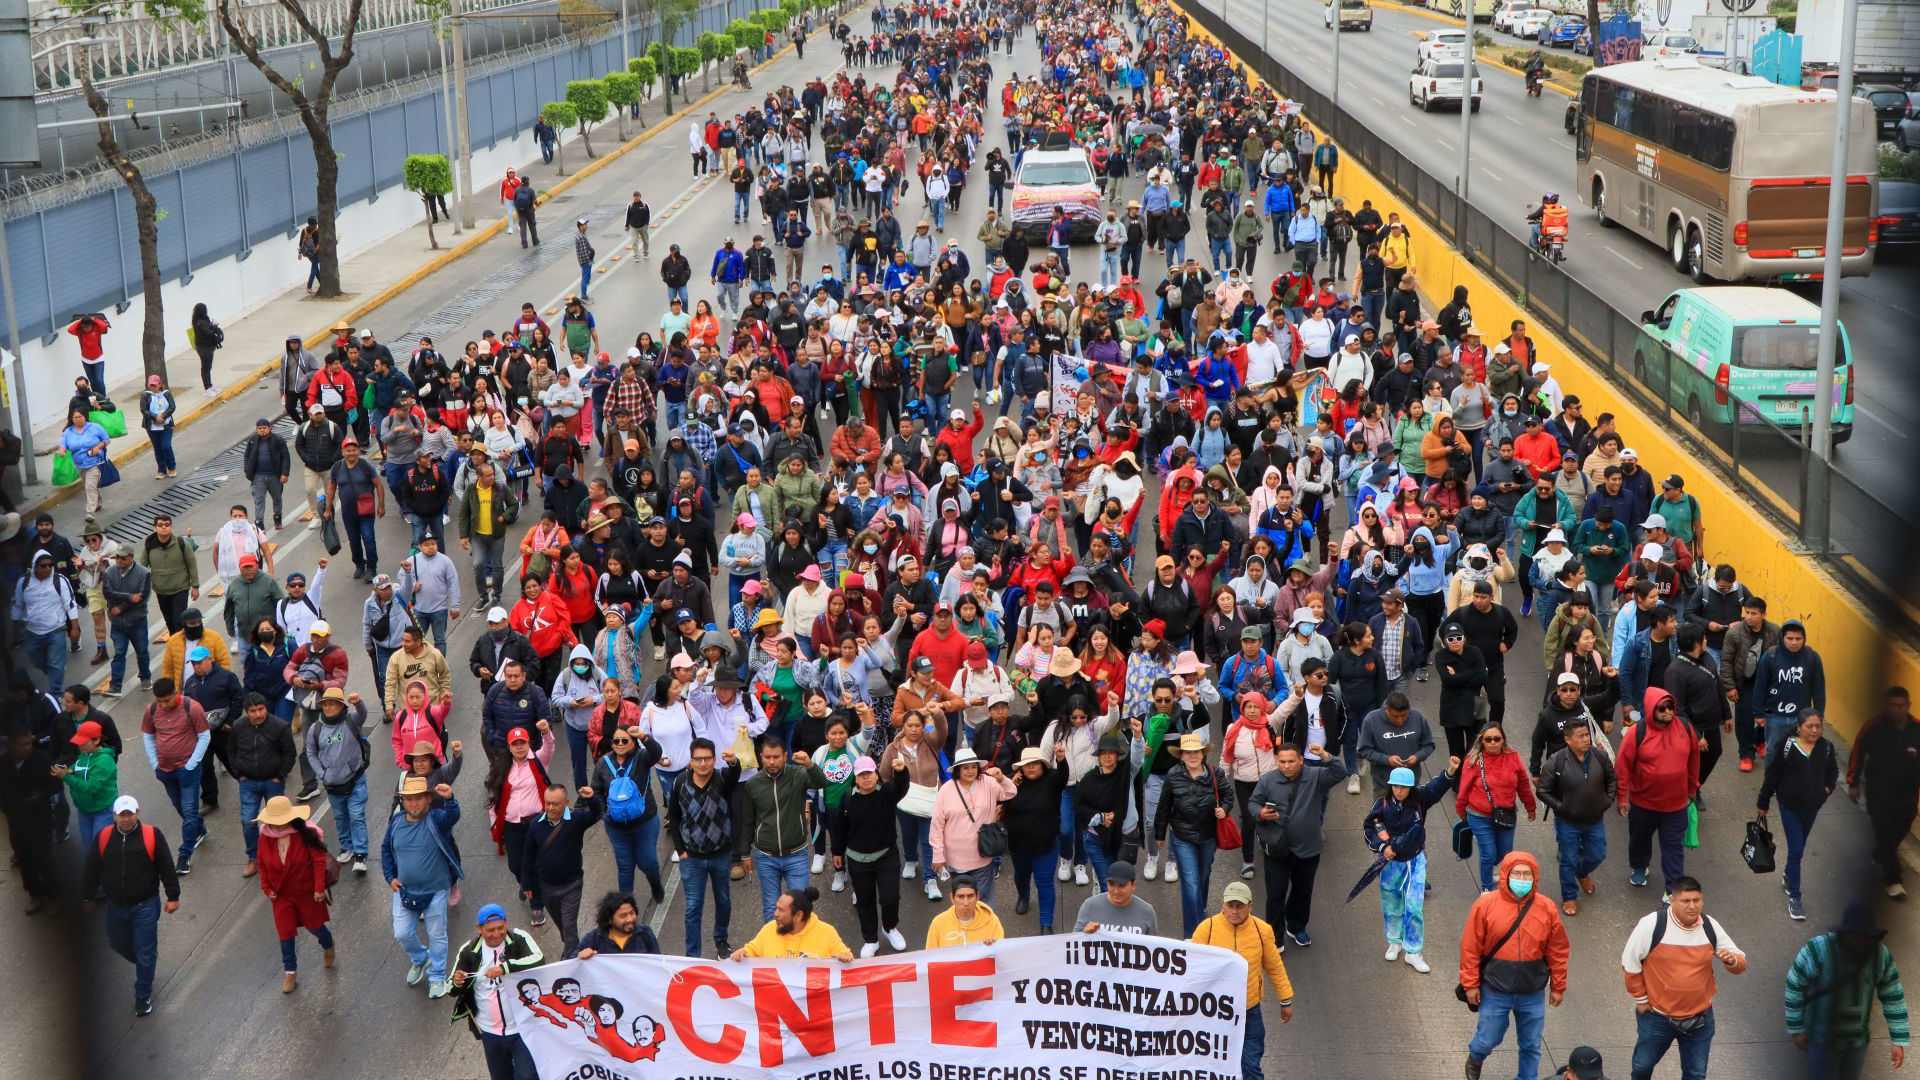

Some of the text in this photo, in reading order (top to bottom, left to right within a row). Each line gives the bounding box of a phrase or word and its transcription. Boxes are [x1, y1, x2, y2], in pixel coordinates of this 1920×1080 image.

[666, 957, 998, 1068] CNTE
[1011, 978, 1240, 1026] Y ORGANIZADOS,
[1022, 1020, 1228, 1061] VENCEREMOS!!
[878, 1061, 921, 1080] LOS
[929, 1062, 1051, 1080] DERECHOS
[1059, 1066, 1088, 1080] SE
